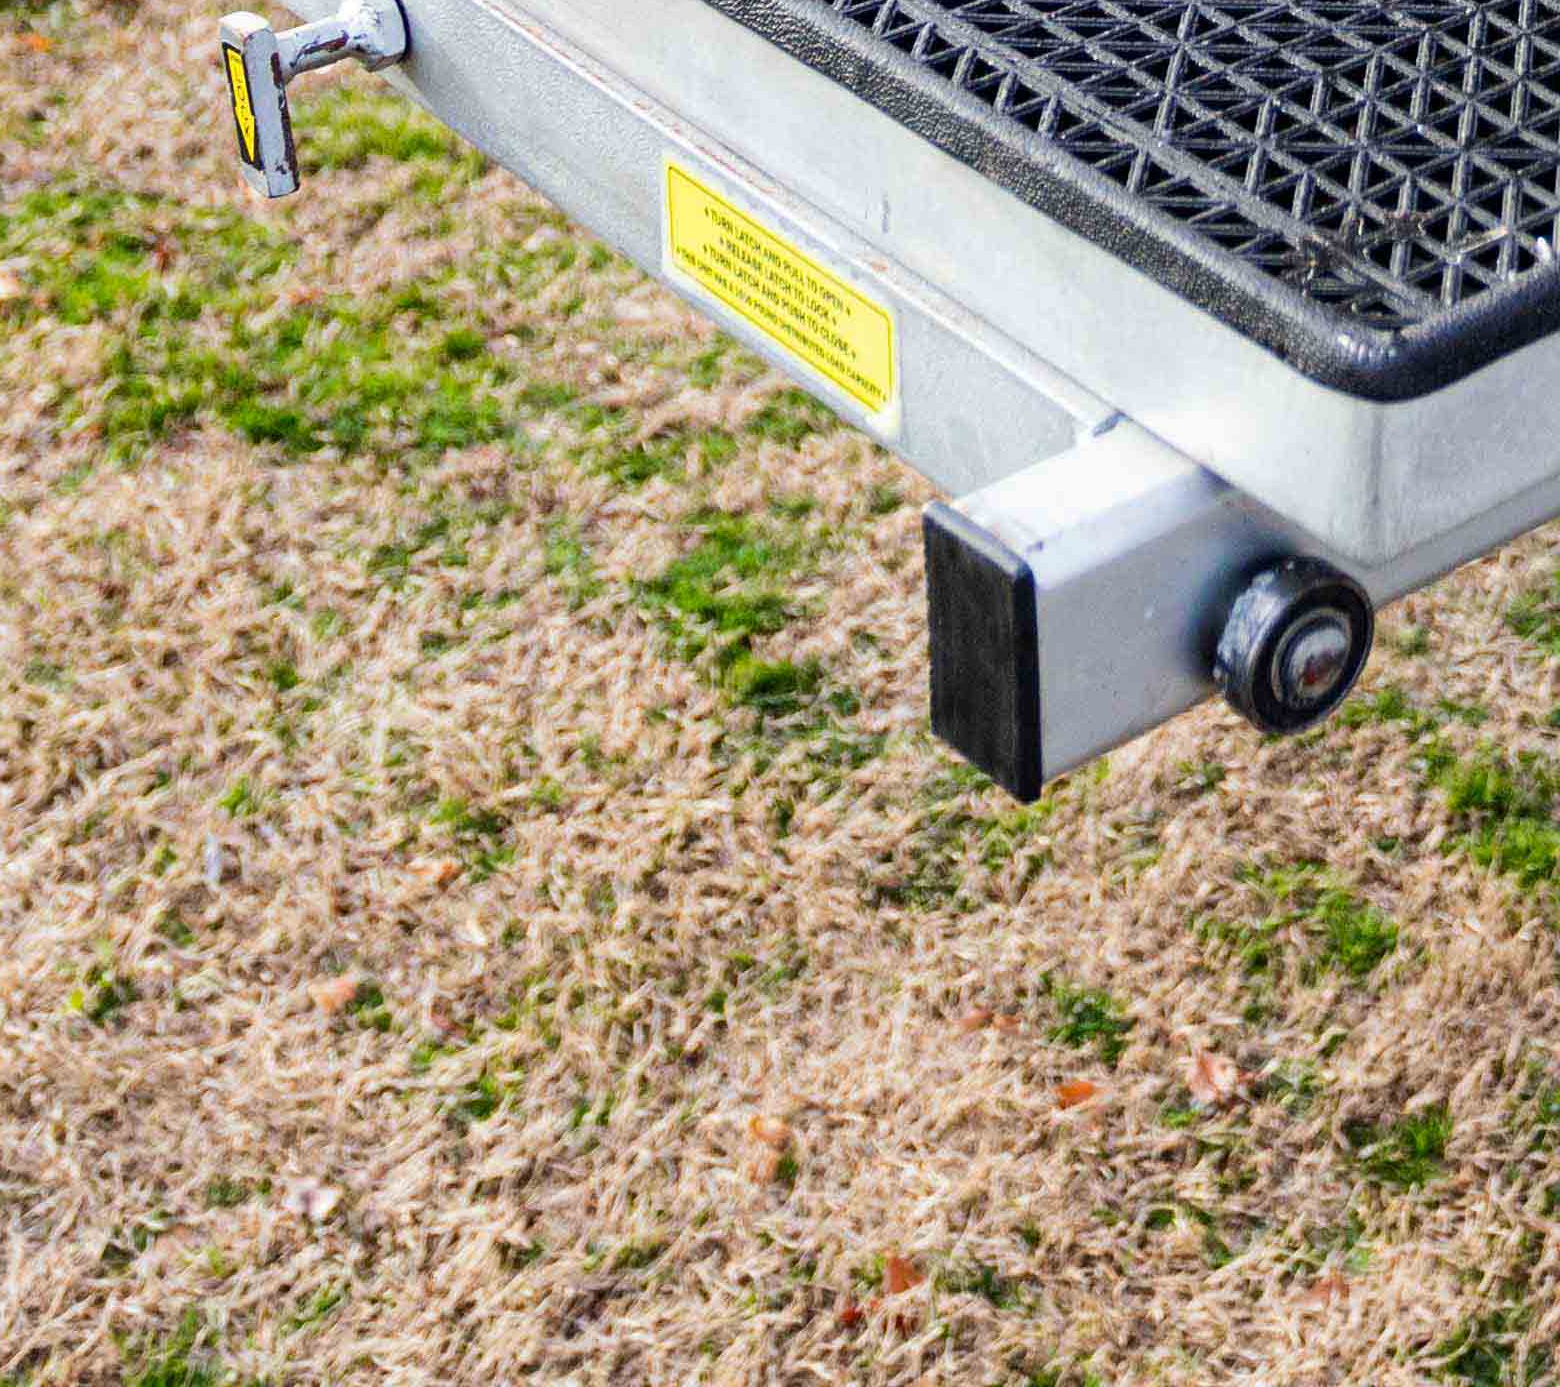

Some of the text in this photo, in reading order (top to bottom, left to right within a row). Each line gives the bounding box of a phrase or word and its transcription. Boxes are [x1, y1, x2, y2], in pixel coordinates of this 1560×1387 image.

[708, 245, 732, 271] TURN
[734, 263, 759, 289] LATCH
[761, 282, 780, 305] AND
[782, 297, 806, 324] PUSH
[807, 317, 818, 334] TO
[820, 326, 850, 355] CLOSE
[710, 208, 844, 313] TURN LATCH AND PULL TO OPEN
[726, 239, 829, 319] RELEASE LATCH TO LOCK
